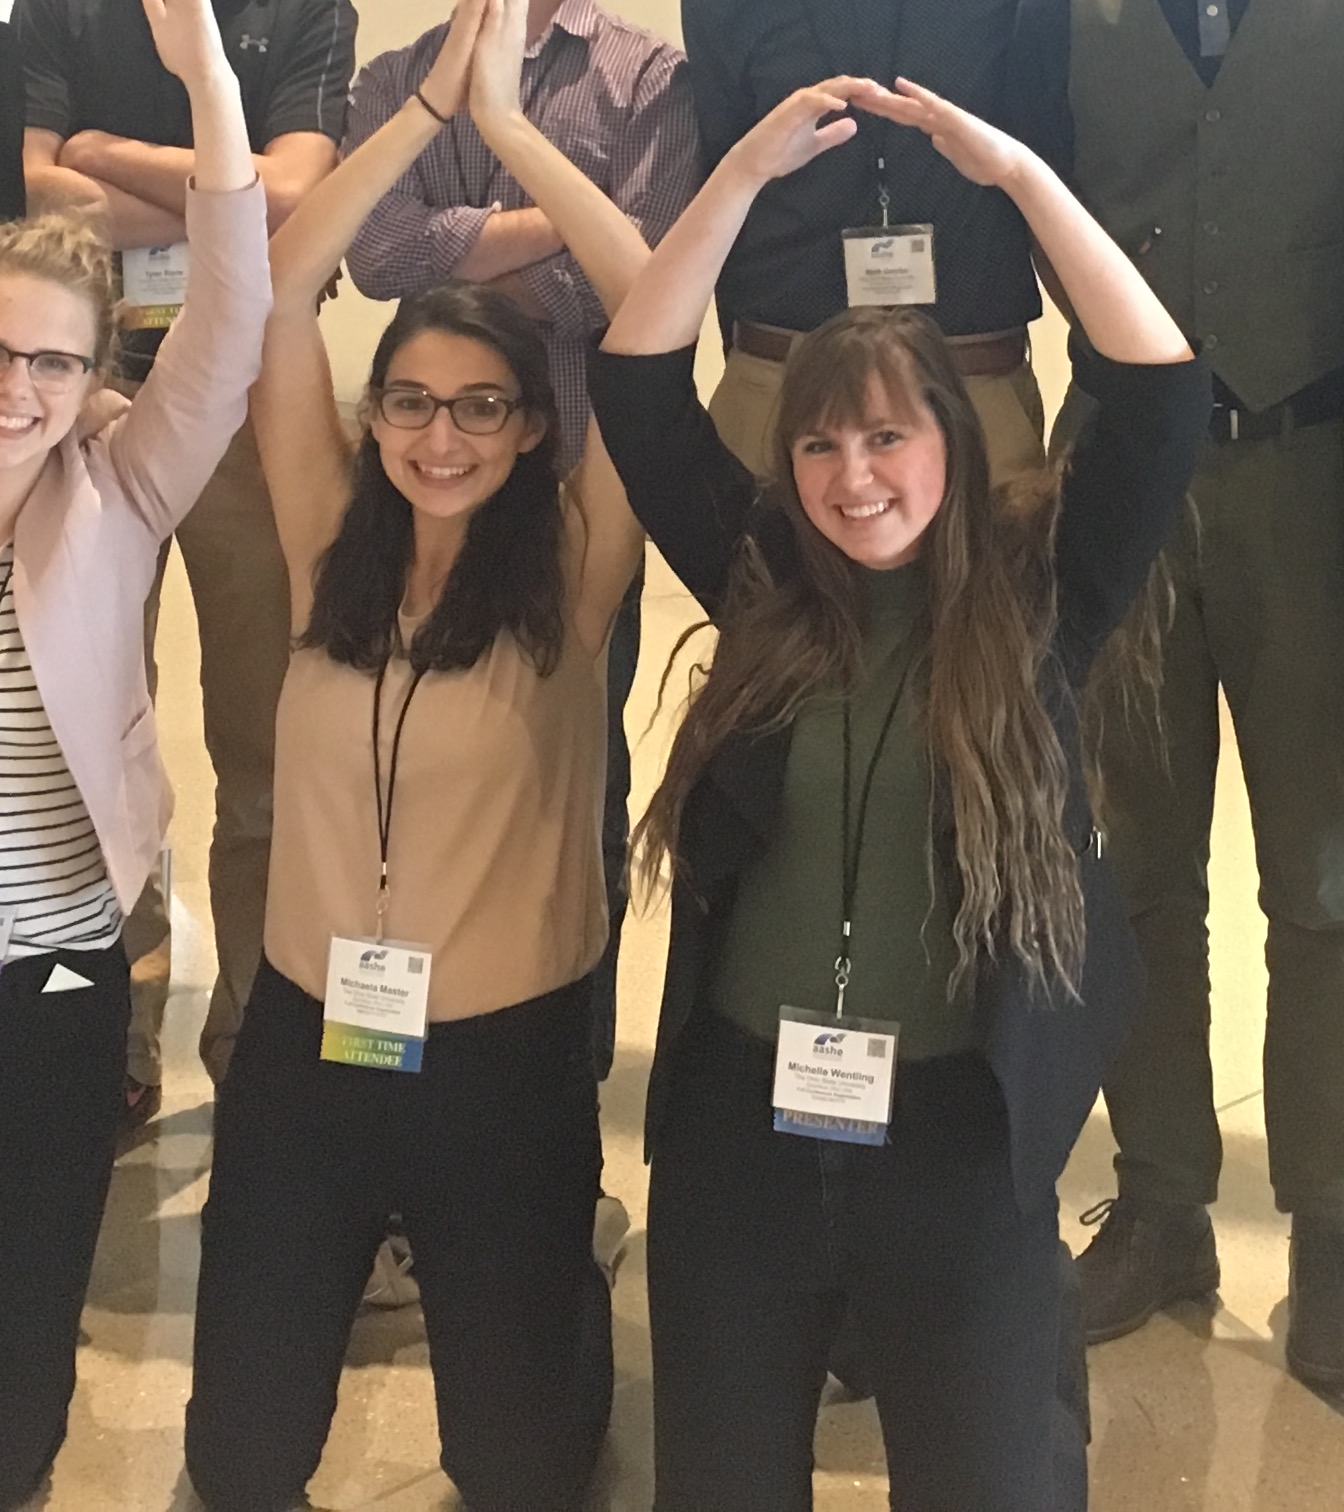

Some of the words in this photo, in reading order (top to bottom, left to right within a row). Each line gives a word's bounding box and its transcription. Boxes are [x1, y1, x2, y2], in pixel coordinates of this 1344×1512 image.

[813, 1045, 843, 1057] aashe
[788, 1061, 828, 1077] Michelle
[830, 1069, 874, 1085] Wentling
[782, 1109, 878, 1134] PRESENTER
